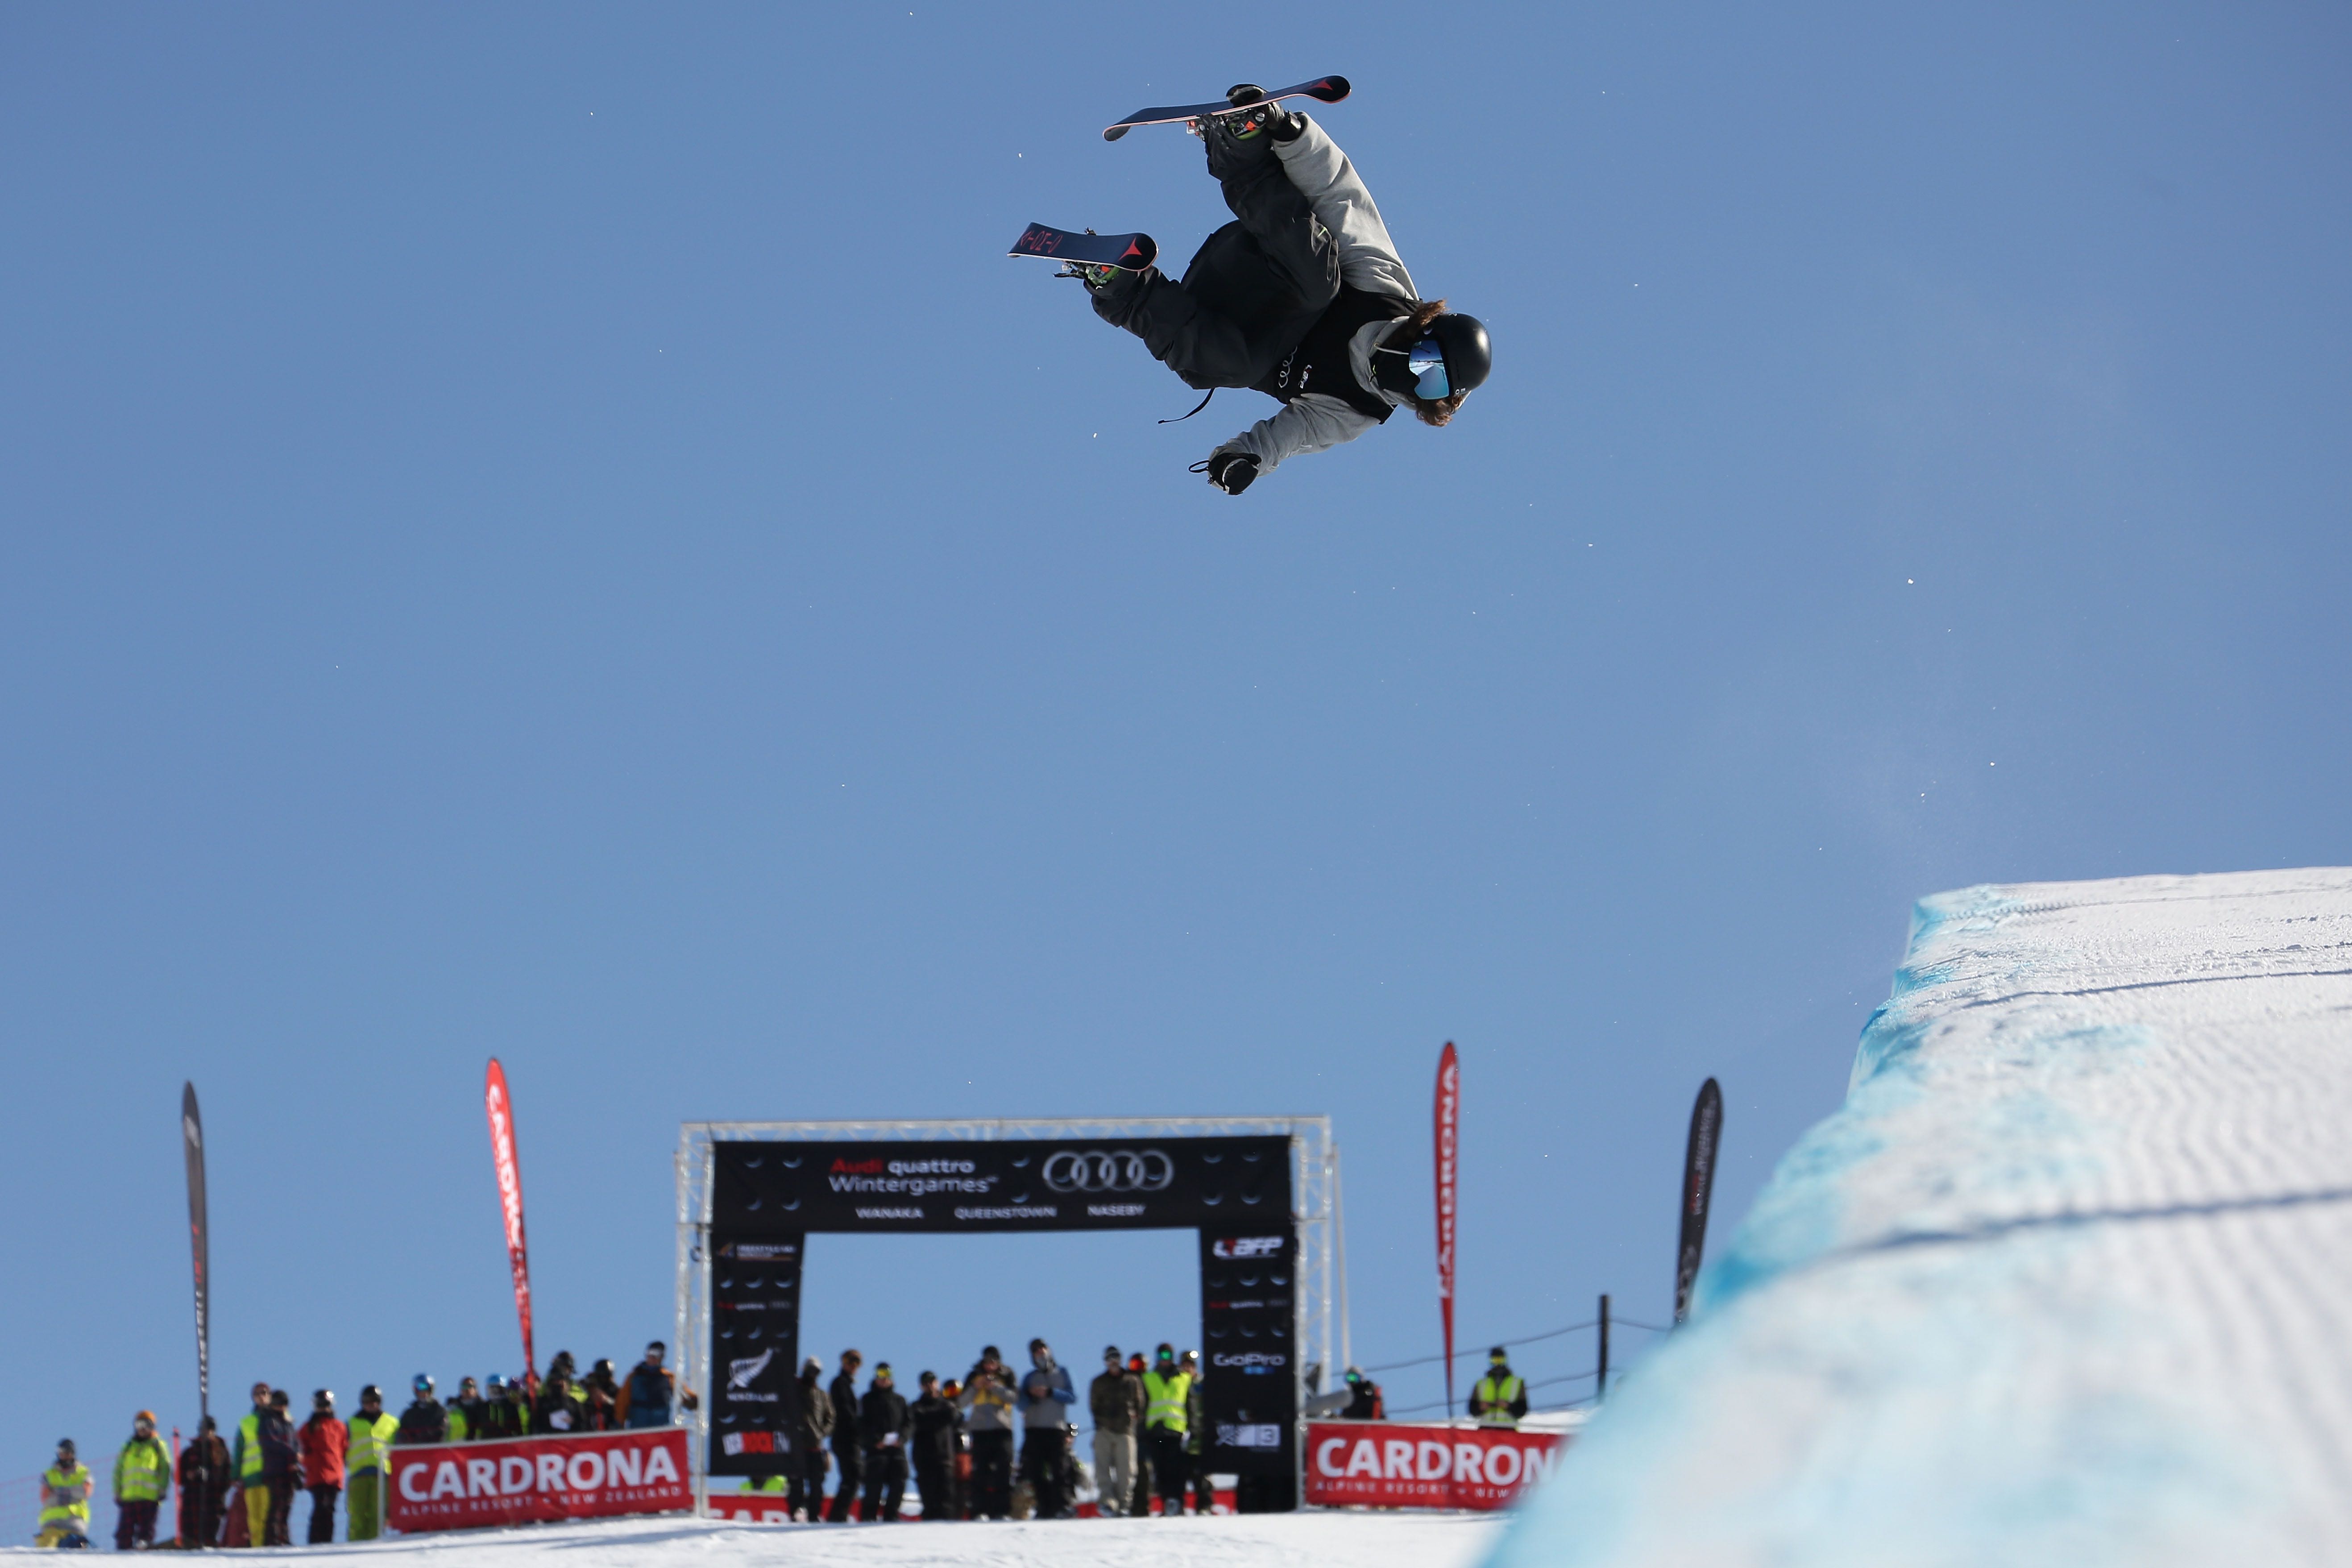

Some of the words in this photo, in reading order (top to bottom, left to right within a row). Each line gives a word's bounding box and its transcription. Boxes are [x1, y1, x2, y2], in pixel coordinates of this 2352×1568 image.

[830, 1159, 883, 1174] Audi
[888, 1159, 975, 1177] quattro
[855, 1207, 924, 1219] WANAKA
[954, 1206, 1057, 1220] QUEENSTOWN
[1087, 1204, 1146, 1216] NASEBY
[398, 1446, 680, 1502] CARDRONA
[1316, 1481, 1377, 1493] ALPINE
[1475, 1487, 1510, 1498] NEW
[399, 1502, 461, 1516] ALPINE
[470, 1496, 533, 1511] RESORT
[560, 1493, 597, 1505] NEW
[605, 1485, 681, 1503] ZEALAND
